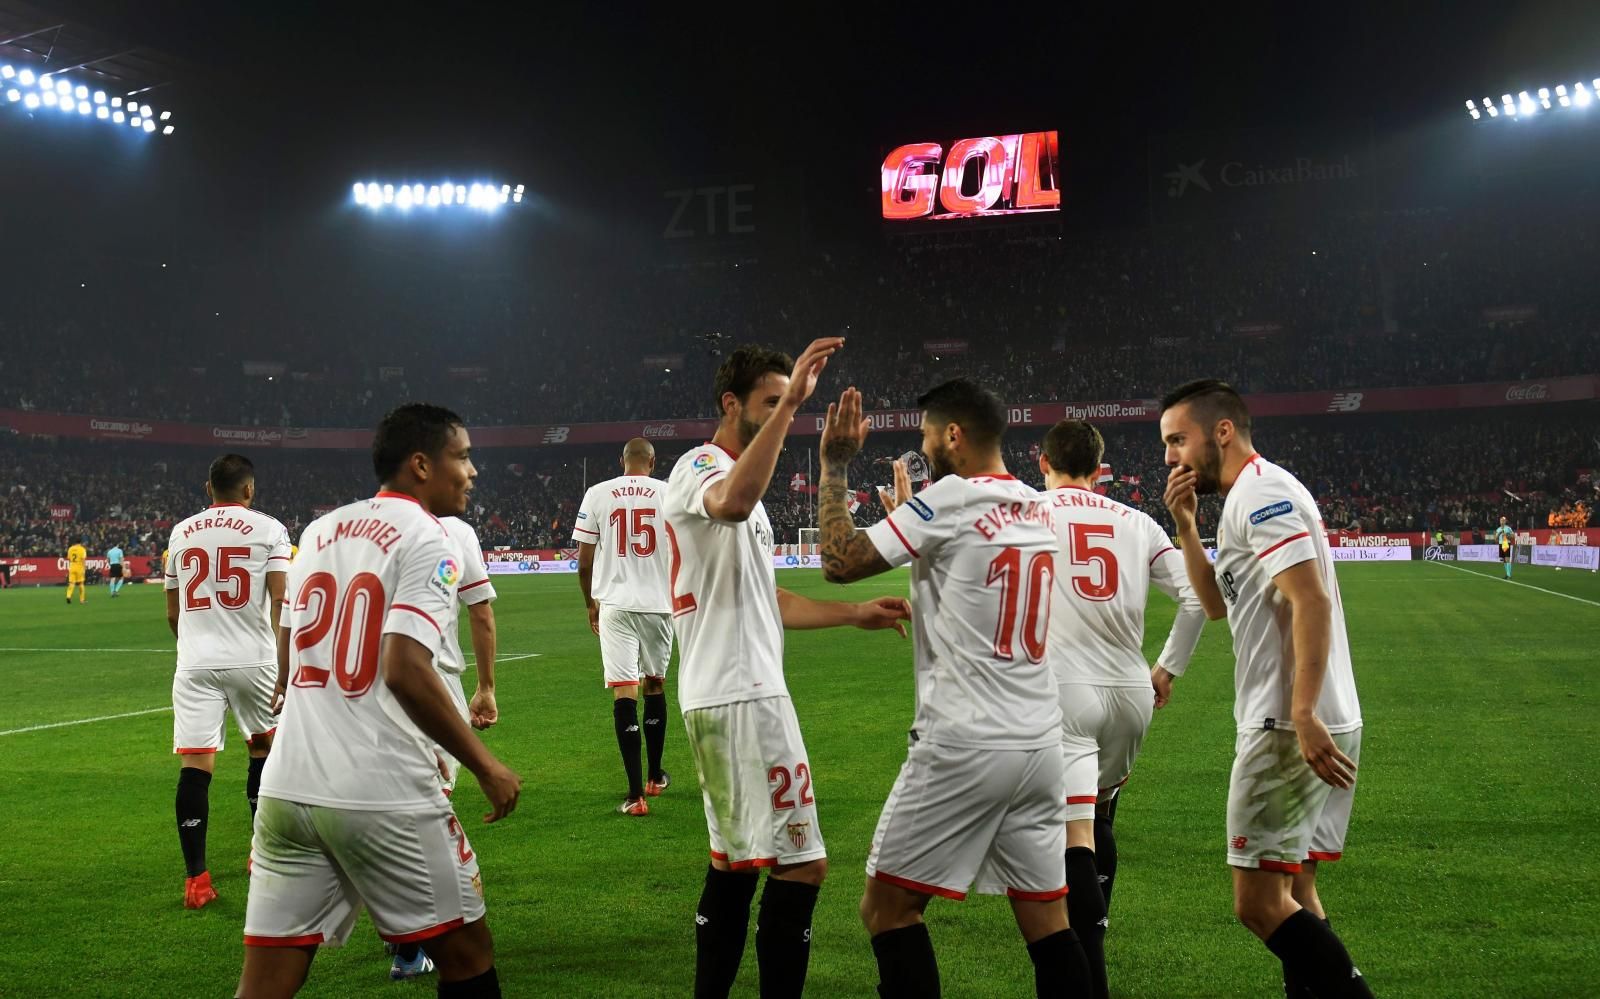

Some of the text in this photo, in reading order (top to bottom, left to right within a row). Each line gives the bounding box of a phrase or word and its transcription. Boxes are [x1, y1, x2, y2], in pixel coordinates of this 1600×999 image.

[882, 131, 1060, 219] GOL
[1220, 154, 1359, 188] CaixaBank
[664, 184, 755, 240] ZTE
[866, 415, 894, 430] QUE
[1065, 404, 1146, 421] PlayWSOP.com
[611, 487, 656, 500] NZONZI
[183, 517, 253, 539] MERCADO
[317, 518, 402, 555] L.MURIEL
[609, 508, 656, 558] 15
[1340, 535, 1409, 548] PlayWSOP.com
[1068, 523, 1118, 602] 5
[1331, 547, 1377, 560] ktail Bar
[181, 546, 251, 612] 25
[985, 546, 1055, 665] 10
[292, 571, 386, 698] 20
[767, 763, 814, 811] 22
